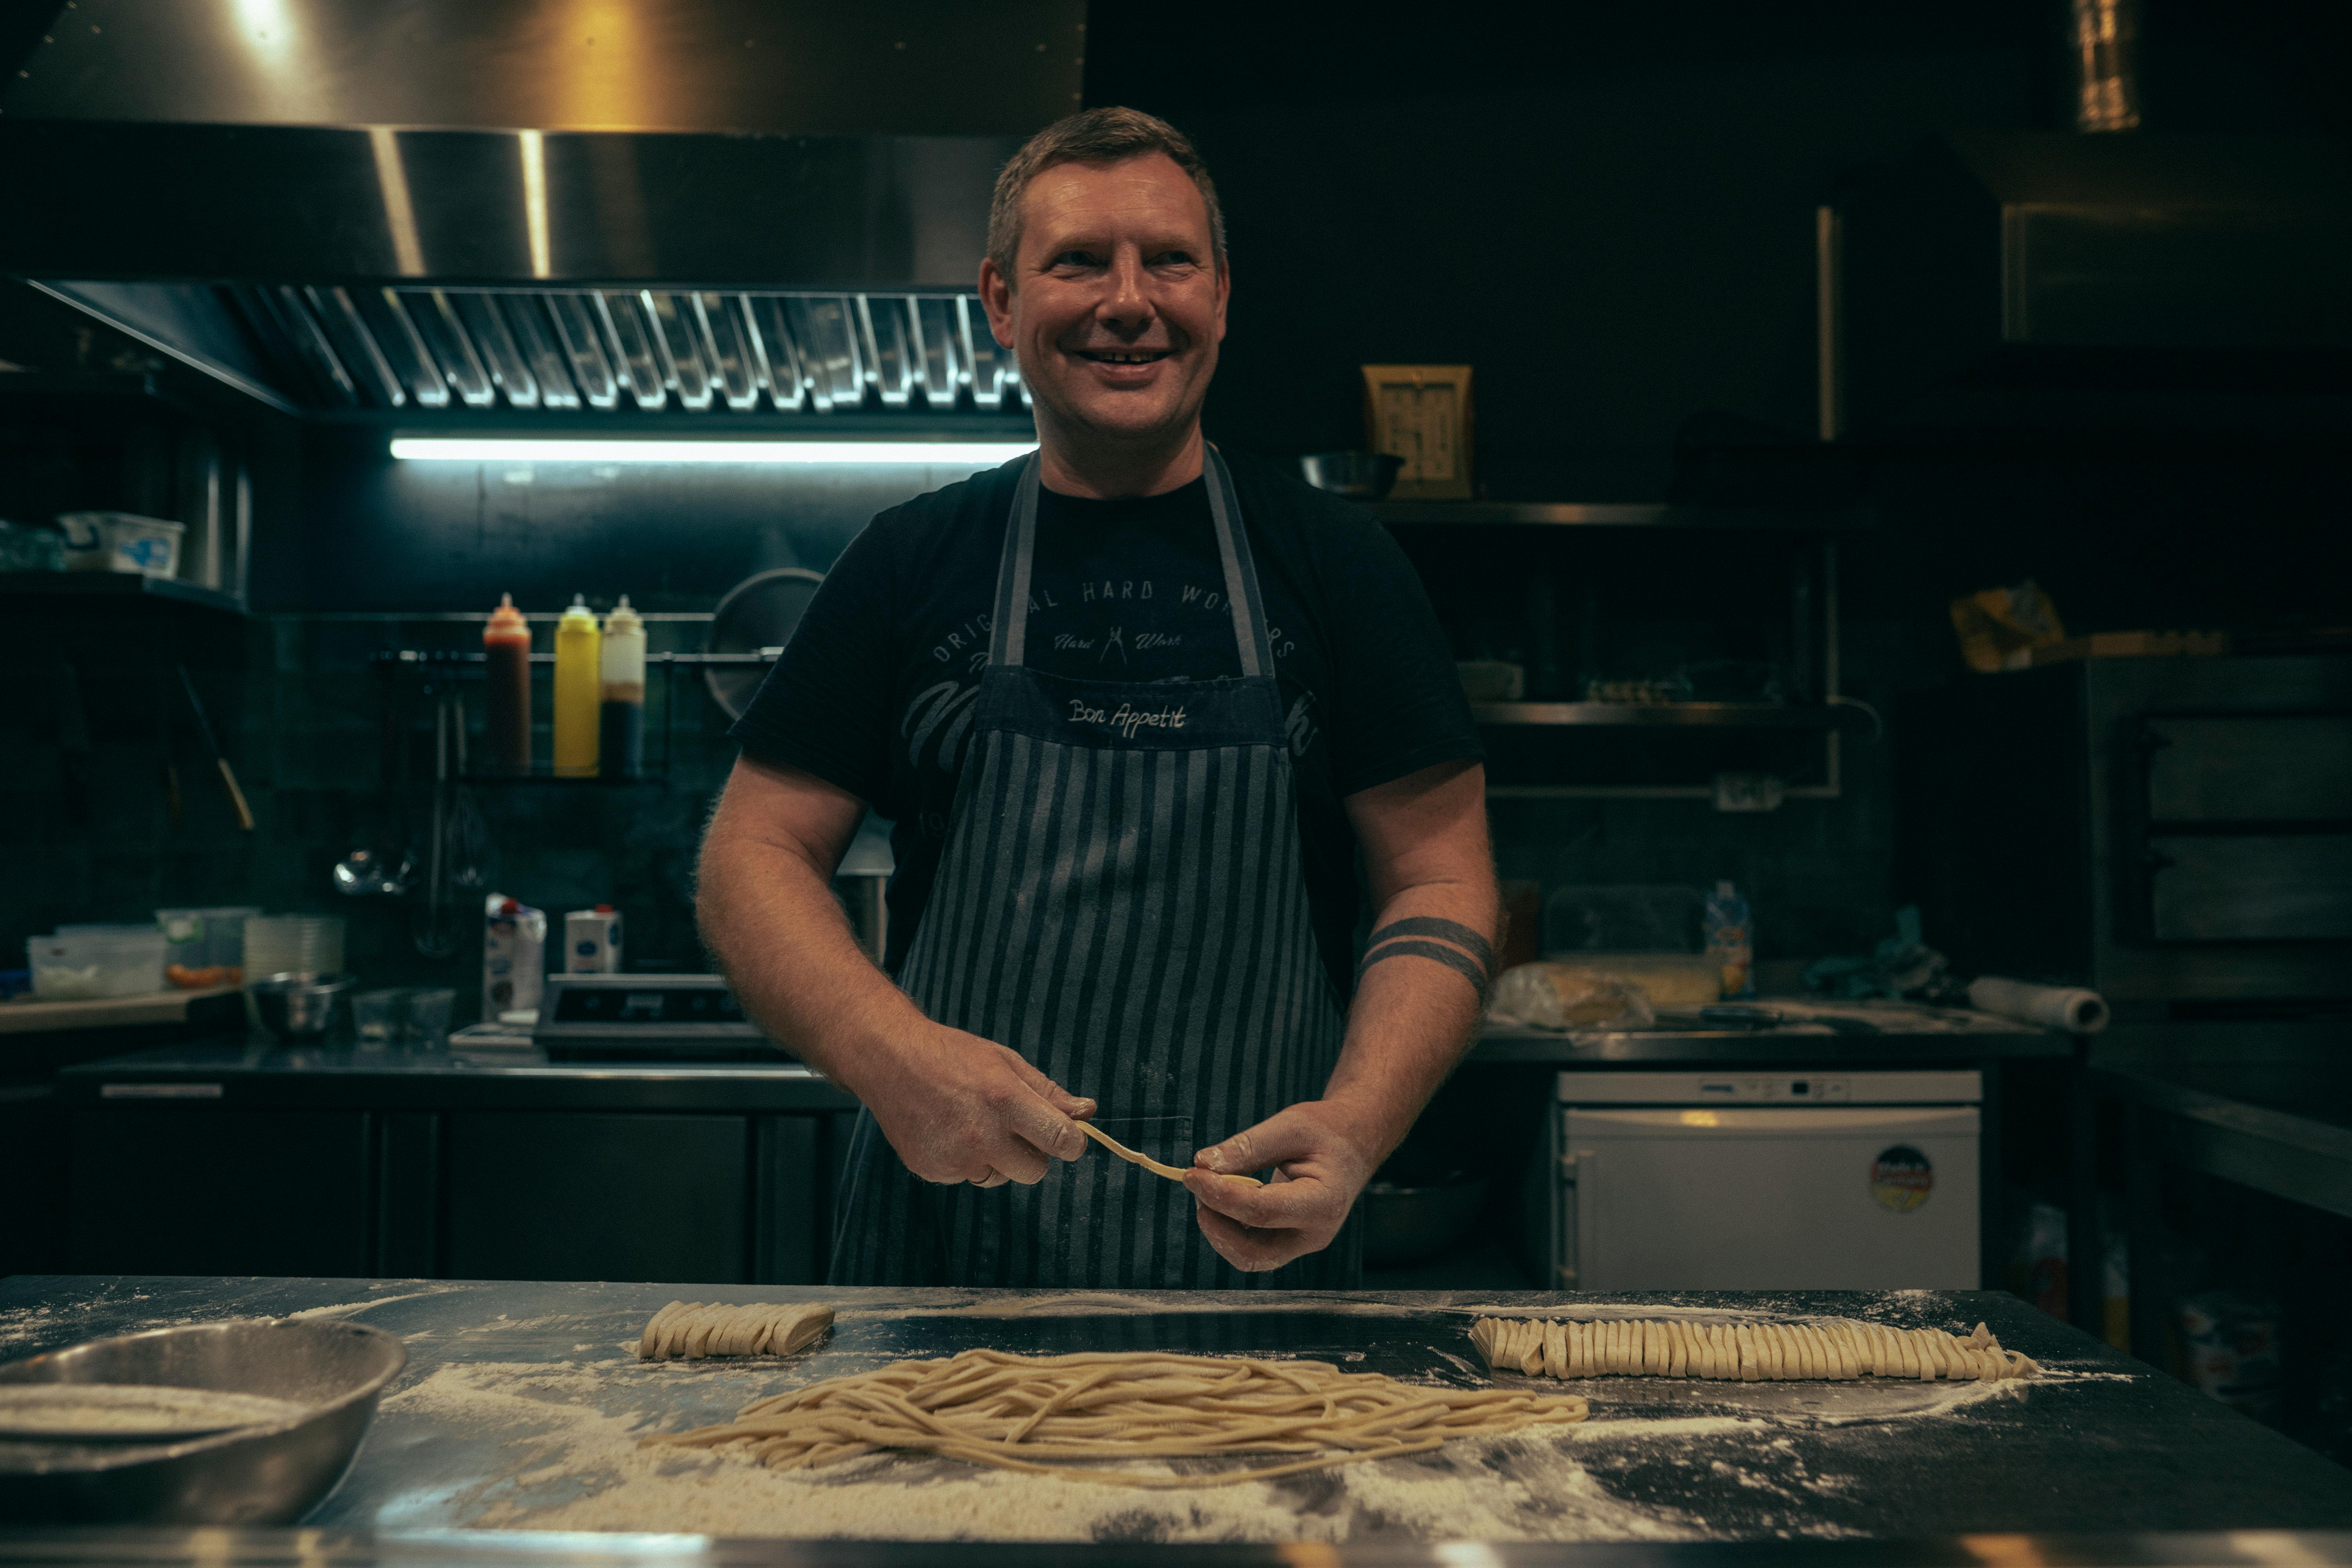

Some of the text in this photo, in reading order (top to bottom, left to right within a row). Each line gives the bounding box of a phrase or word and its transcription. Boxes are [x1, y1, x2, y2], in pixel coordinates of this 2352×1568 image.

[933, 580, 1295, 662] ORIGAL HARD WORS
[1054, 632, 1182, 651] Hard Work
[1068, 699, 1187, 739] Bon Appetit
